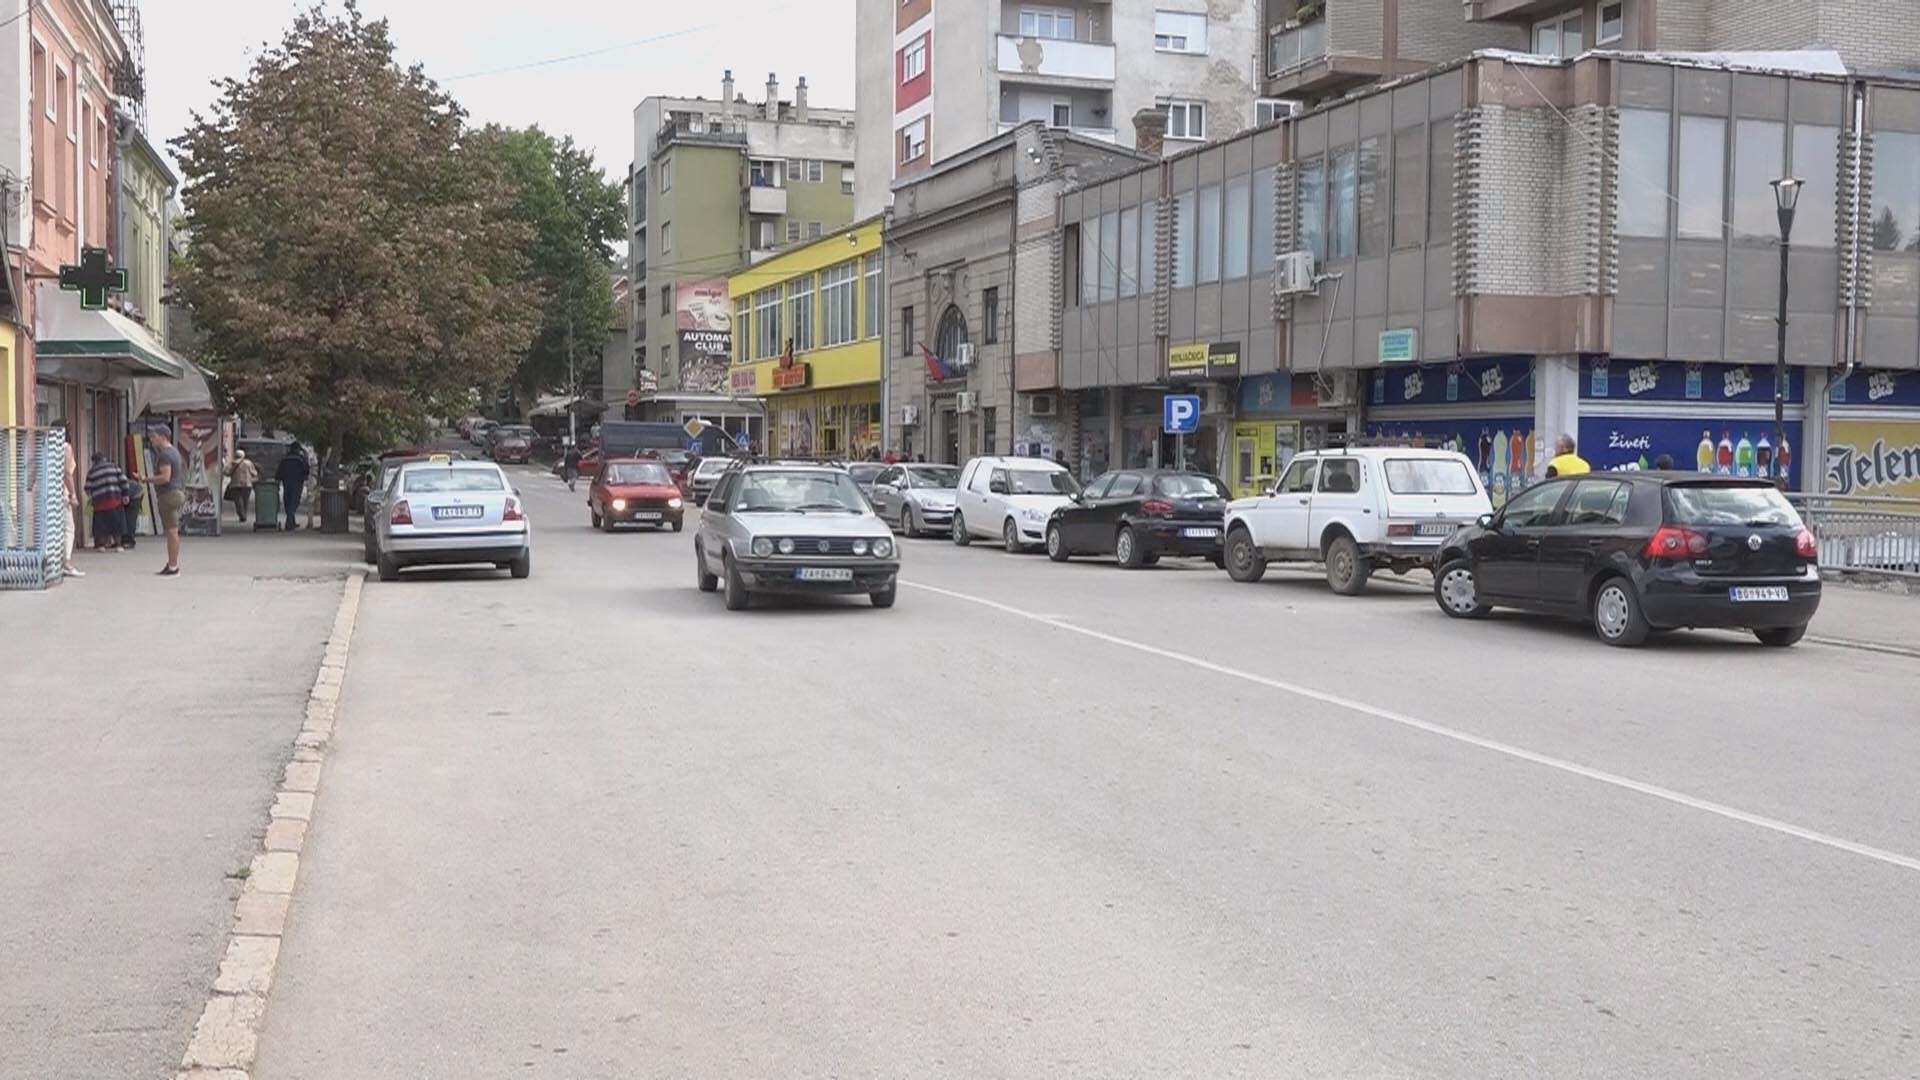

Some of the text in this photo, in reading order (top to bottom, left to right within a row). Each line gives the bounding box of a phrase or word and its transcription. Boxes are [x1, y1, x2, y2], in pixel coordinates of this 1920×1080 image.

[683, 332, 732, 343] AUTOMA
[694, 342, 724, 351] CLUB
[1171, 400, 1193, 429] P
[1608, 430, 1650, 449] Živeti
[1826, 439, 1920, 495] Jelen
